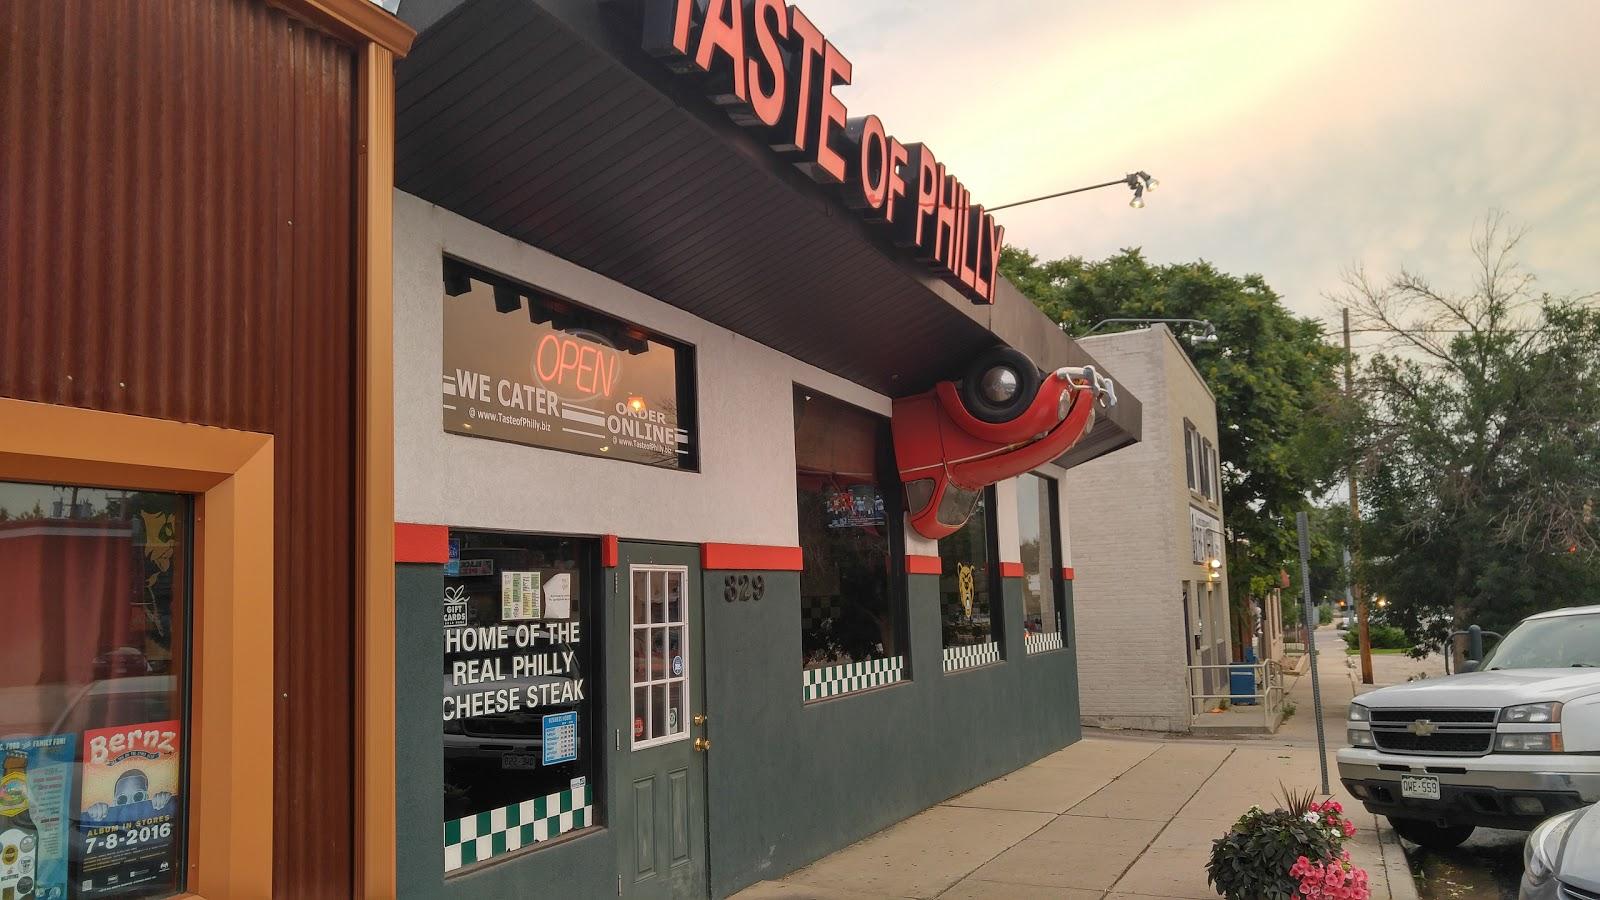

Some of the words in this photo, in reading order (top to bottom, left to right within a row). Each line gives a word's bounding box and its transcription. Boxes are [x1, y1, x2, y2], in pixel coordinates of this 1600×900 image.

[861, 114, 908, 224] OF
[915, 142, 1005, 305] PHILLY
[536, 334, 615, 397] OPEN
[456, 368, 491, 403] WE
[498, 379, 560, 417] CATER
[468, 407, 476, 418] @
[477, 410, 551, 432] www.TasteofPhilly.biz
[615, 402, 666, 425] ORDER
[607, 415, 674, 446] ONLINE
[724, 574, 765, 603] 829
[444, 612, 466, 622] CARDS
[446, 605, 463, 614] GIFT
[446, 626, 508, 653] HOME
[515, 624, 540, 647] OF
[546, 622, 580, 644] THE
[453, 658, 506, 686] REAL
[512, 651, 574, 679] PHILLY
[442, 687, 520, 721] CHEESE
[526, 678, 585, 708] STEAK
[90, 729, 176, 765] Bernz
[85, 822, 171, 854] 7-8-2016
[87, 824, 119, 837] ALBUM
[122, 822, 132, 830] IN
[135, 814, 170, 827] STORES
